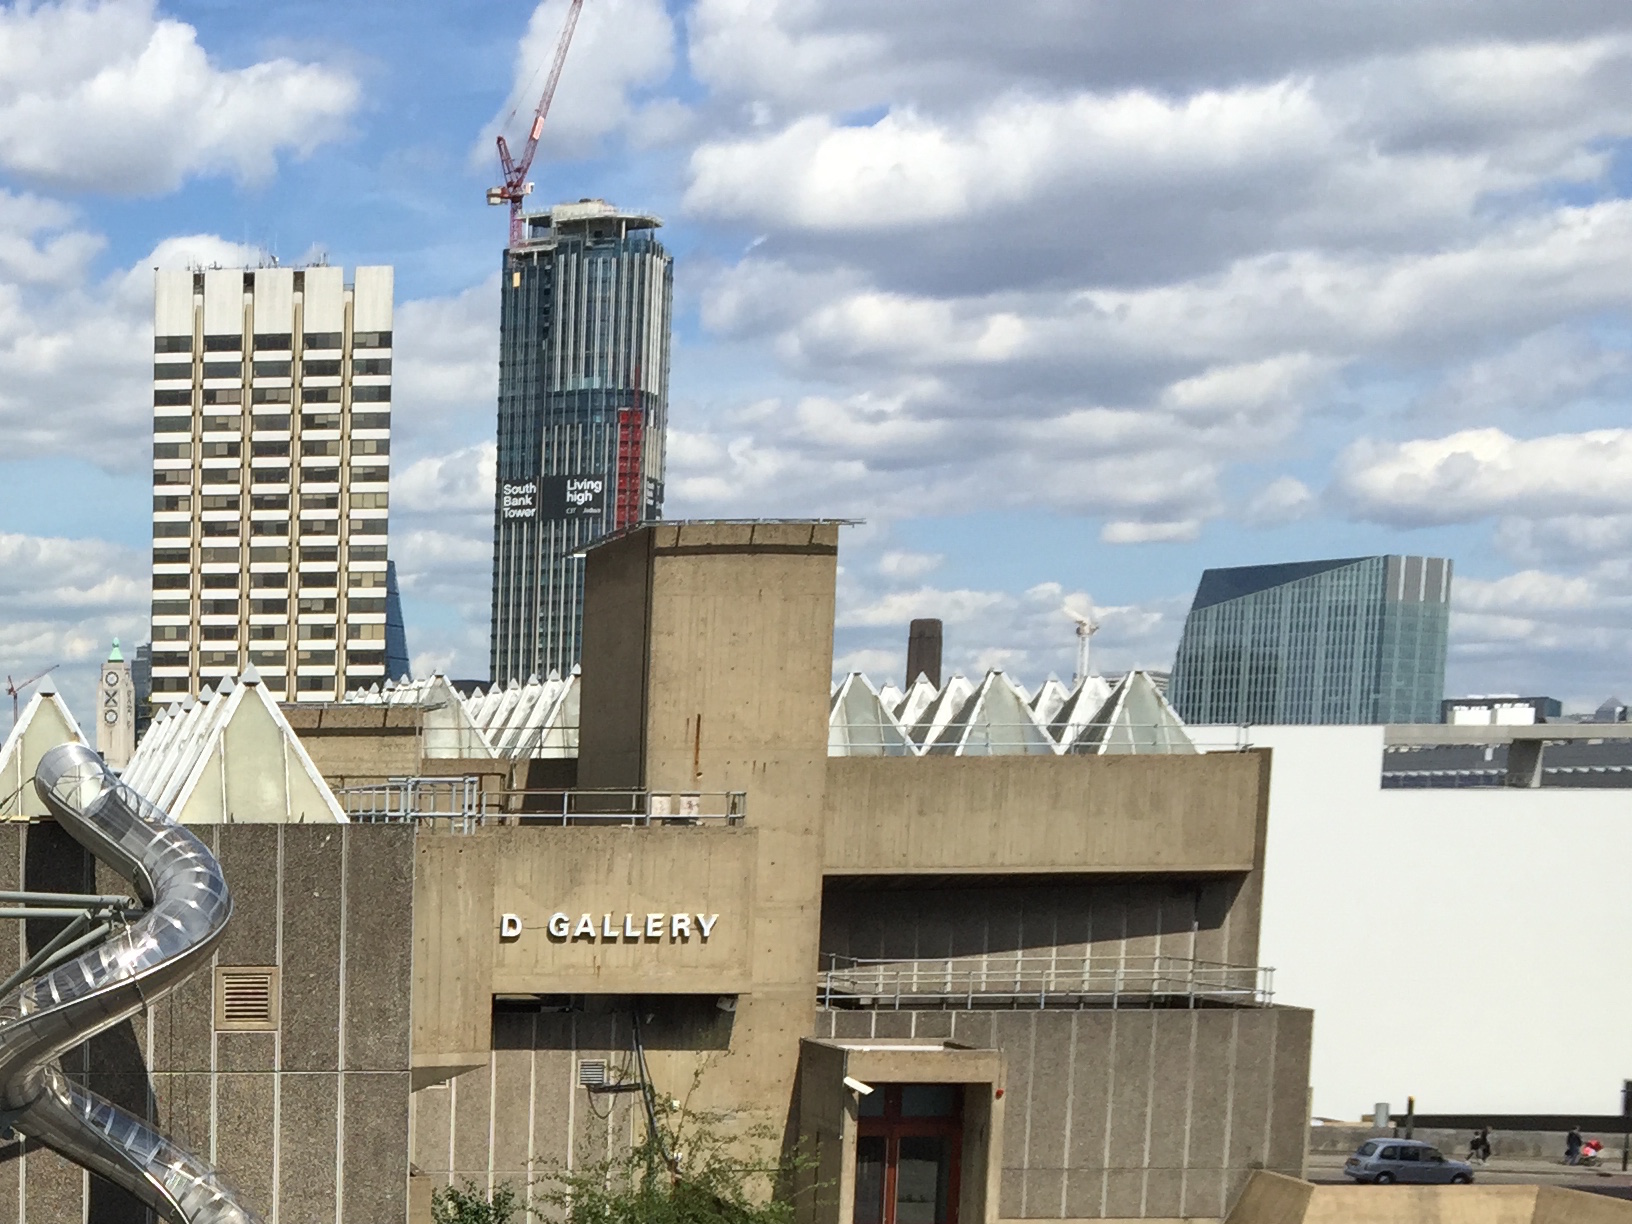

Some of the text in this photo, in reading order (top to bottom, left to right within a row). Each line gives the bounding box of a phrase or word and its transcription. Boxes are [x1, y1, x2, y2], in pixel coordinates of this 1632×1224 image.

[503, 482, 536, 495] South
[567, 479, 602, 493] Living
[503, 495, 532, 506] Bank
[566, 490, 592, 505] high
[503, 507, 536, 518] Tower
[105, 671, 119, 724] OXO
[501, 912, 719, 938] D GALLERY
